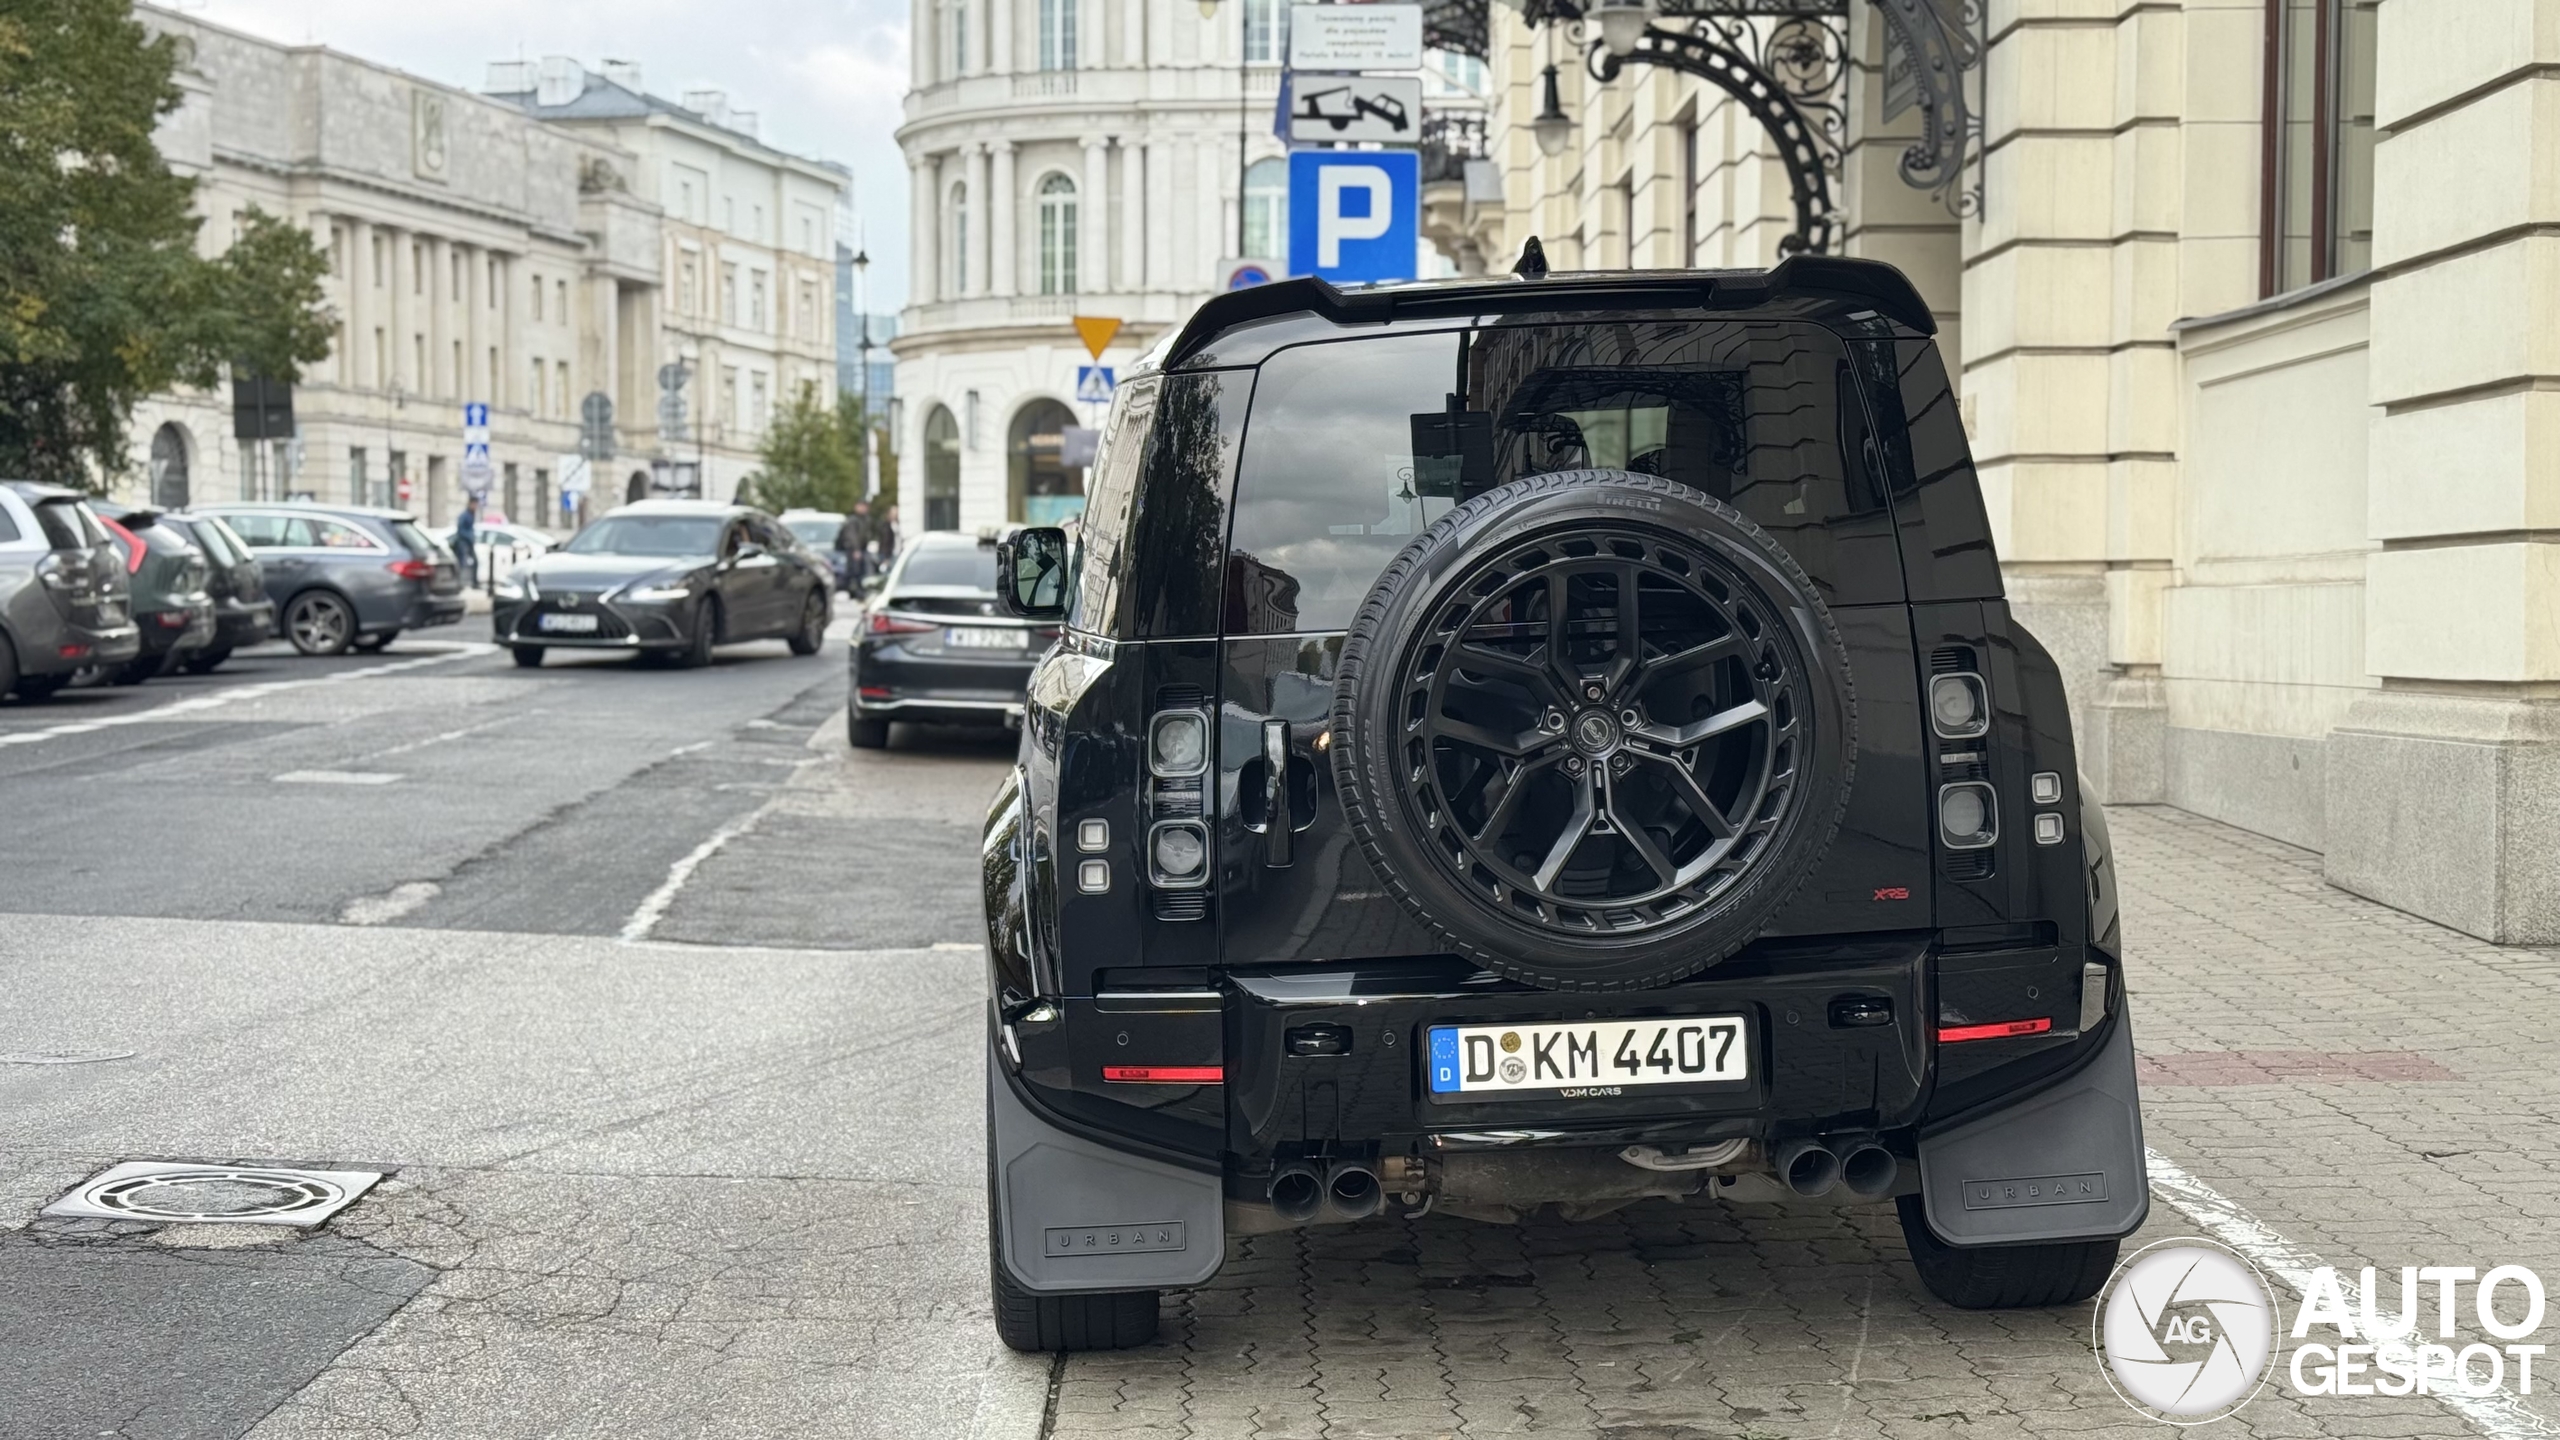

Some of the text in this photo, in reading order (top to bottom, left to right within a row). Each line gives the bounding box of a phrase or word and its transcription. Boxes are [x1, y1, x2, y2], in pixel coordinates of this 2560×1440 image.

[1317, 165, 1393, 269] P
[1597, 489, 1662, 511] PIRELLI
[1464, 1025, 1737, 1083] D KM 4407
[1439, 1067, 1451, 1082] D
[1588, 1086, 1622, 1097] CARS
[1979, 1181, 2092, 1199] URBAN
[1059, 1230, 1170, 1247] URBAN
